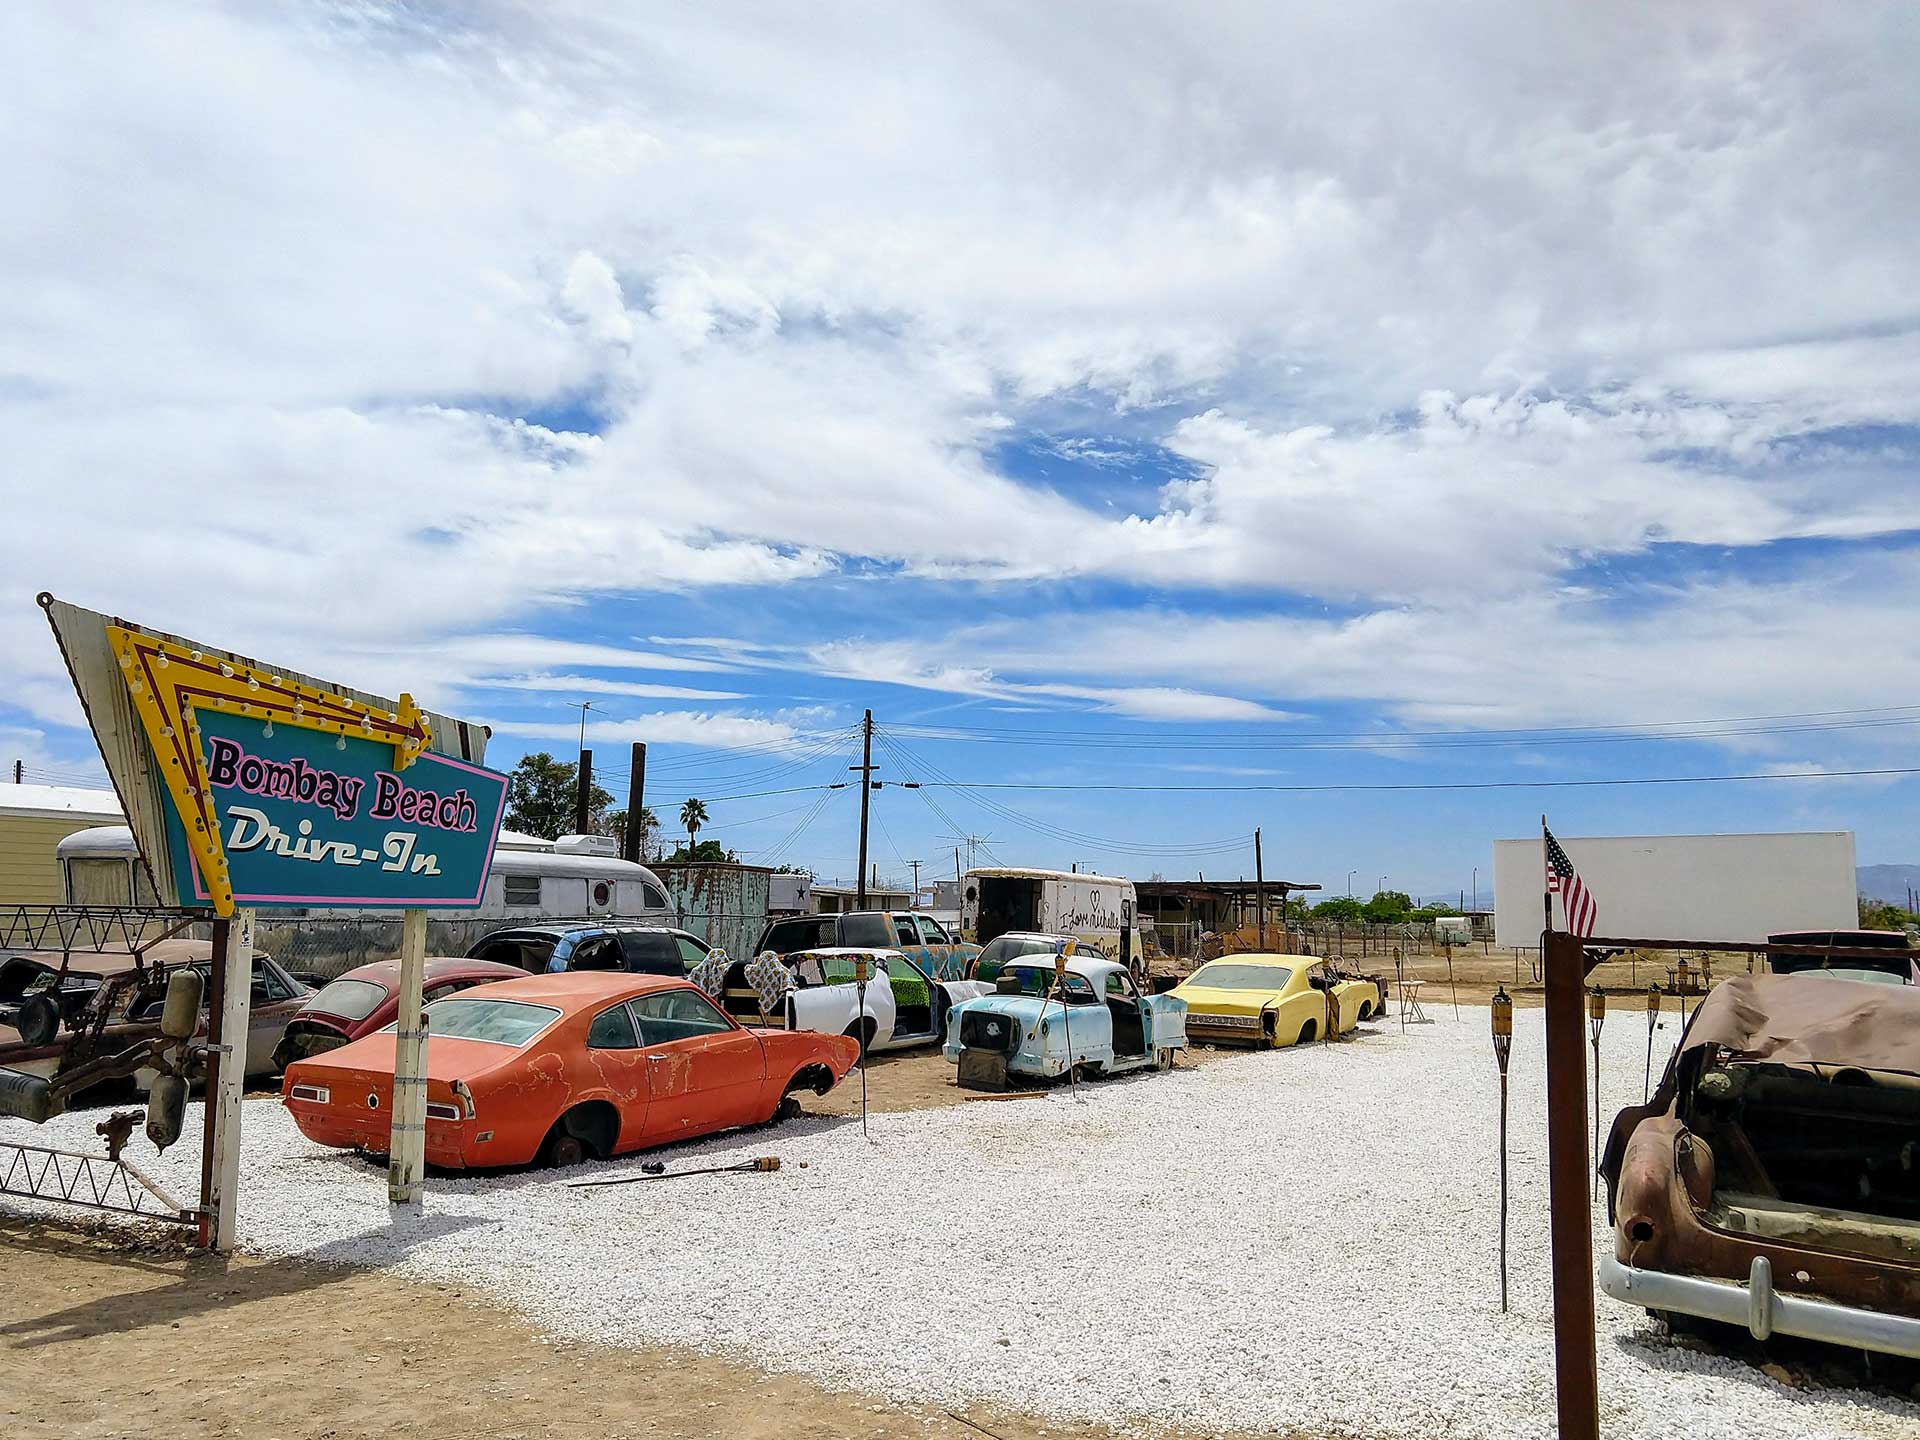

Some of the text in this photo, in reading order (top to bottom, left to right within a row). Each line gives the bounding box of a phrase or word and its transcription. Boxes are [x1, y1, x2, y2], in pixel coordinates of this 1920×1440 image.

[209, 736, 477, 832] Bombay Beach
[227, 806, 442, 875] Drive-In
[1060, 912, 1068, 929] I
[1068, 908, 1089, 931] Love
